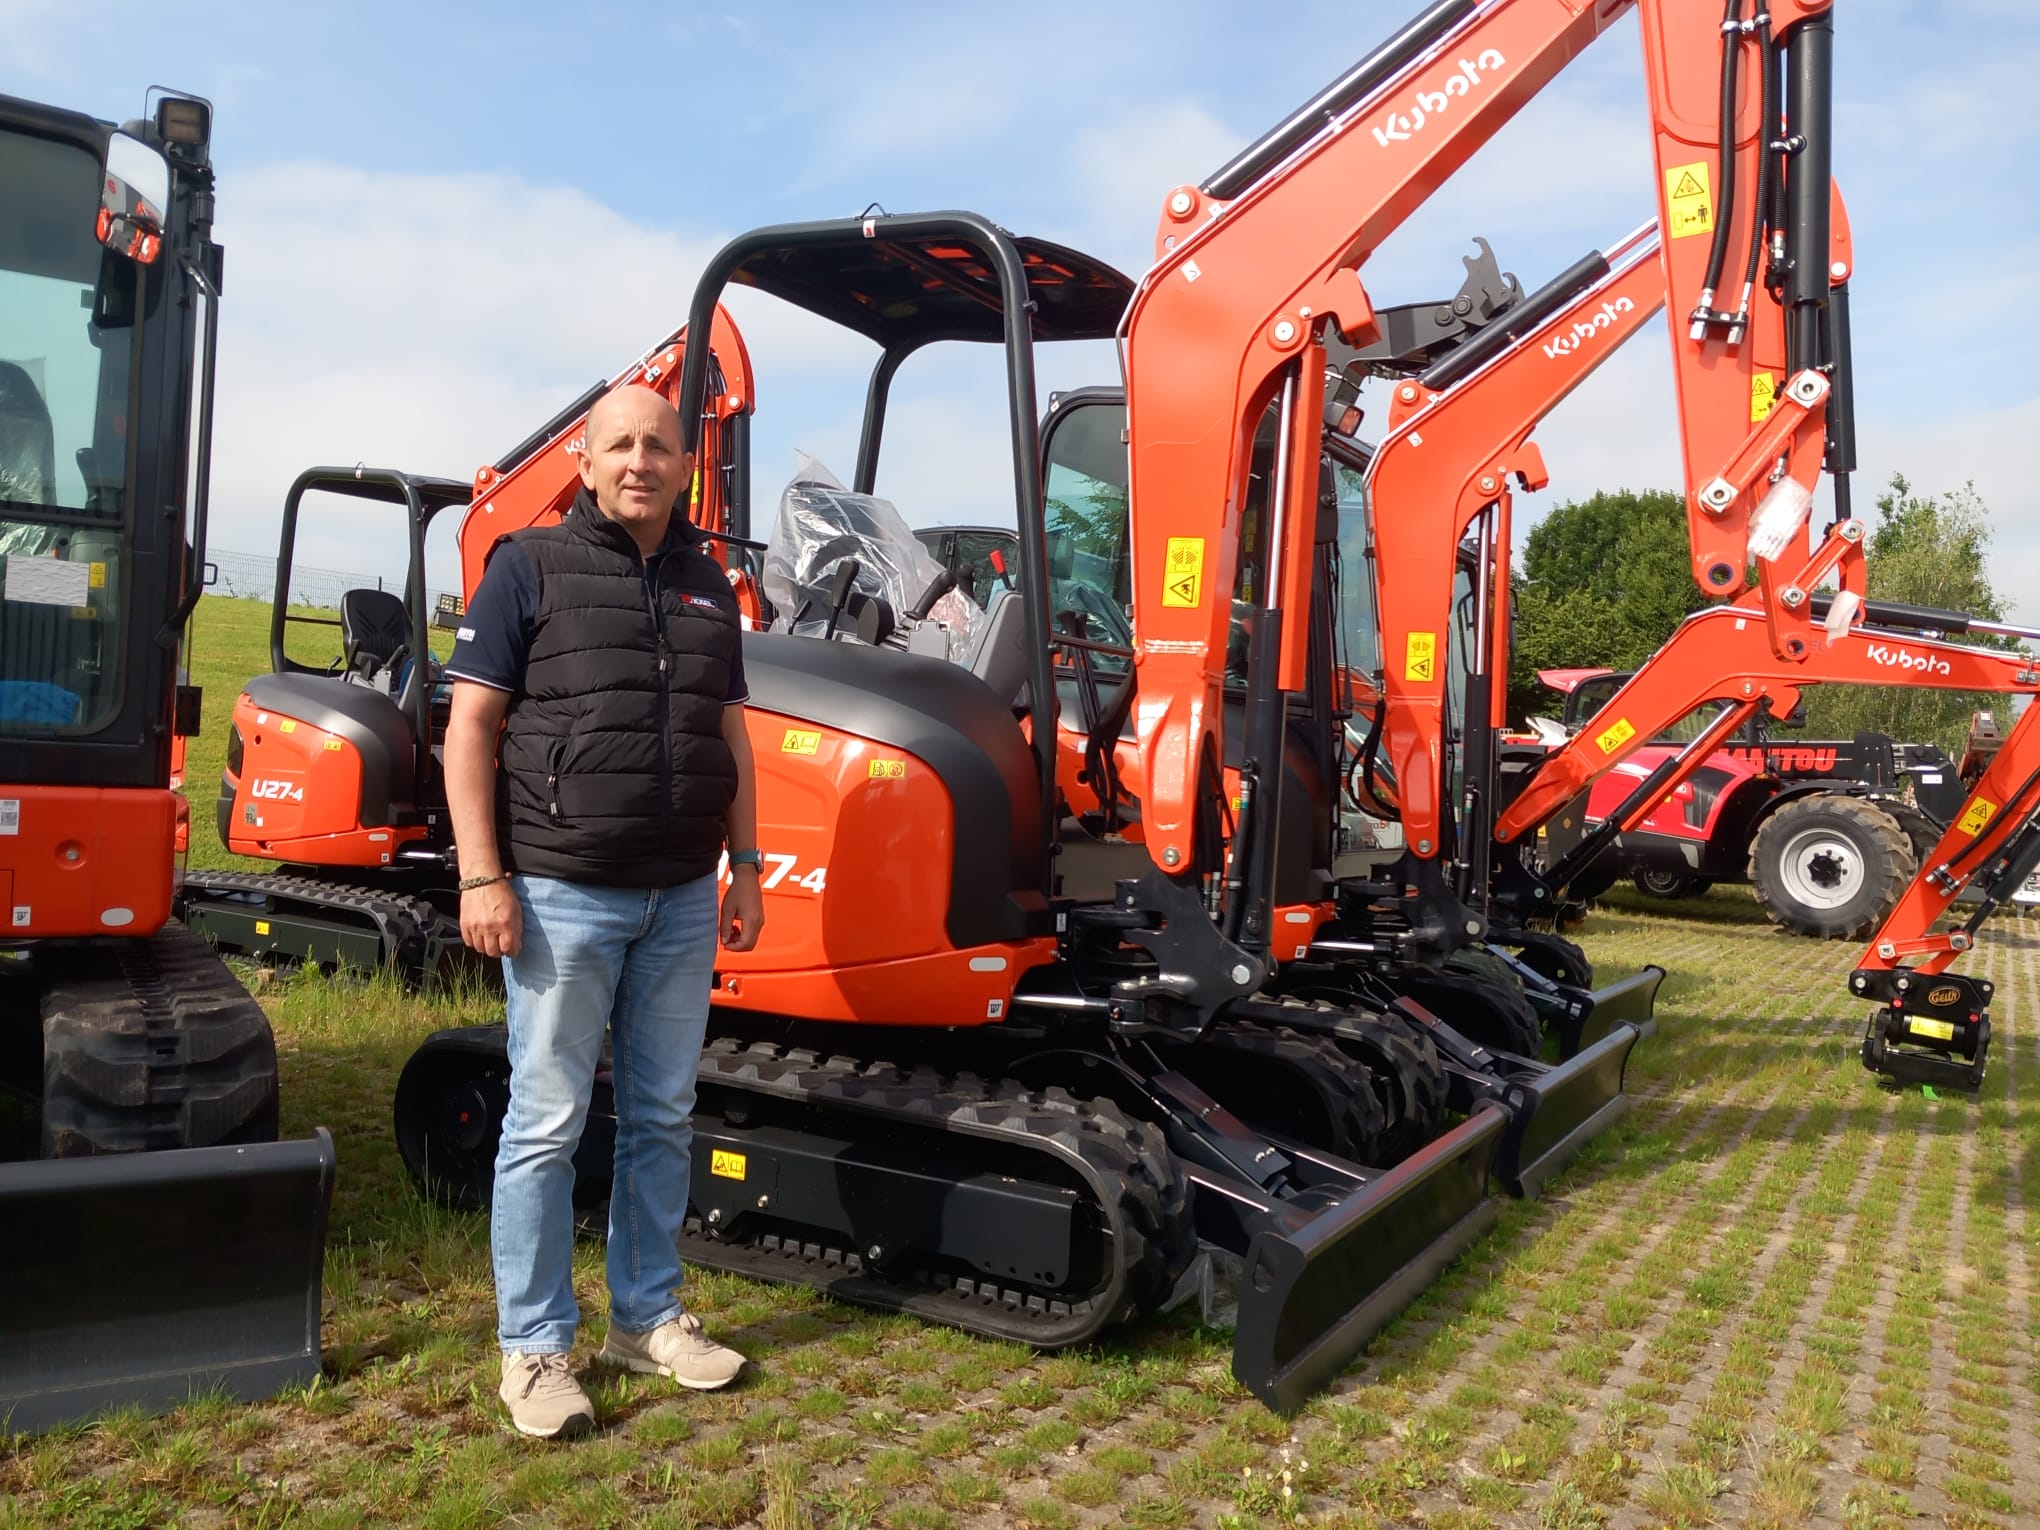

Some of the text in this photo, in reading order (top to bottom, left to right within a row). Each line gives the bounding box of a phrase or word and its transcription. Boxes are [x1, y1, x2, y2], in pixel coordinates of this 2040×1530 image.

[1371, 48, 1506, 148] Kubota
[1542, 296, 1635, 360] Kubota
[1866, 644, 1951, 676] Kubota
[251, 778, 304, 802] U27-4
[717, 849, 828, 894] 7-4
